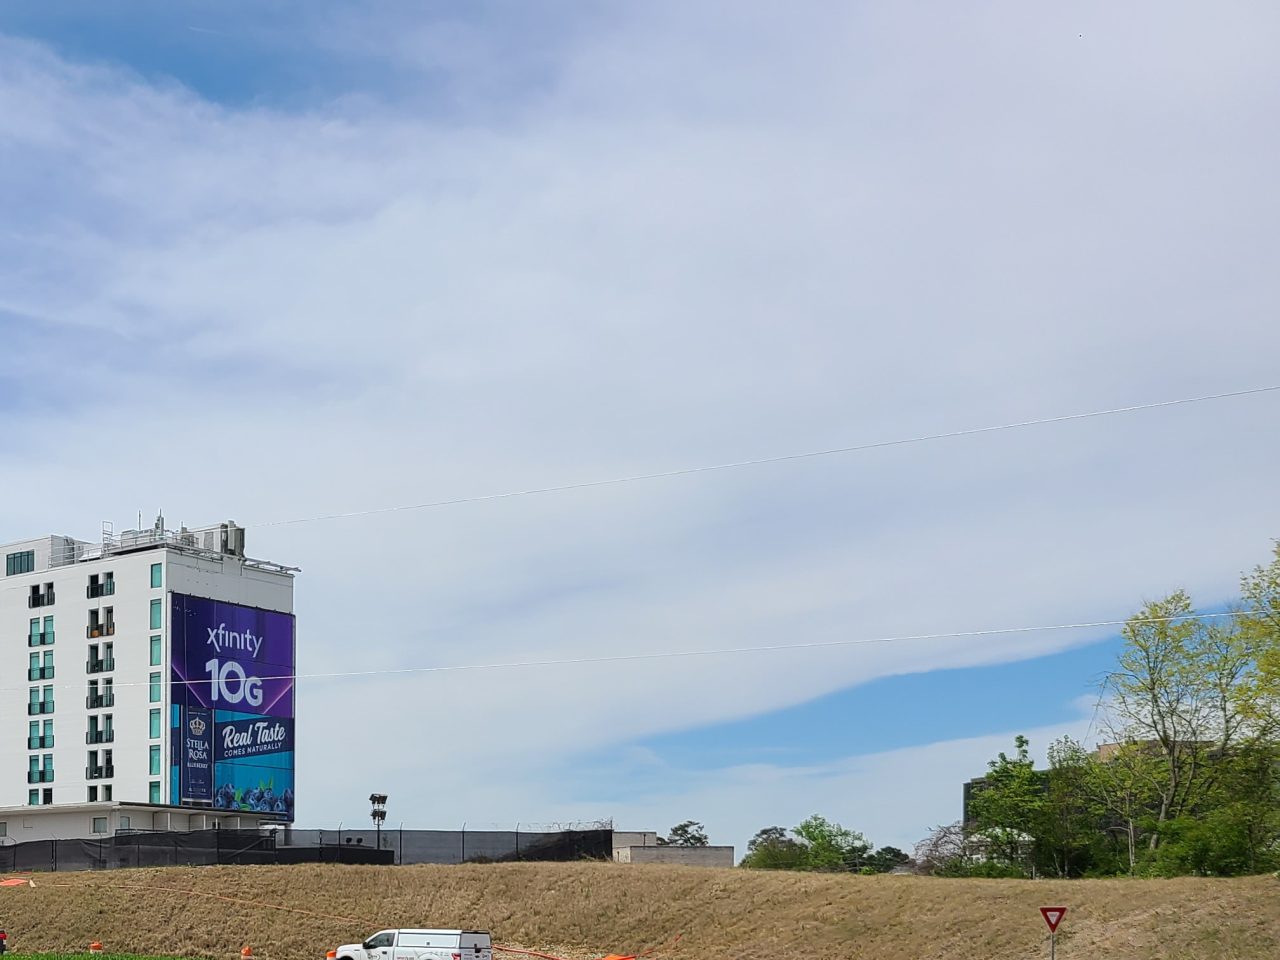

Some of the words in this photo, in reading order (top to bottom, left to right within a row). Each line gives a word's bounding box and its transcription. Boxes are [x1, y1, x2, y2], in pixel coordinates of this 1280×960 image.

[206, 623, 263, 658] xfinity
[205, 658, 263, 707] 10G
[186, 738, 209, 750] STELLA
[222, 724, 252, 749] Real
[254, 721, 286, 742] Taste
[188, 749, 207, 760] ROSA
[224, 748, 245, 757] COMES
[247, 742, 282, 753] NATURALLY
